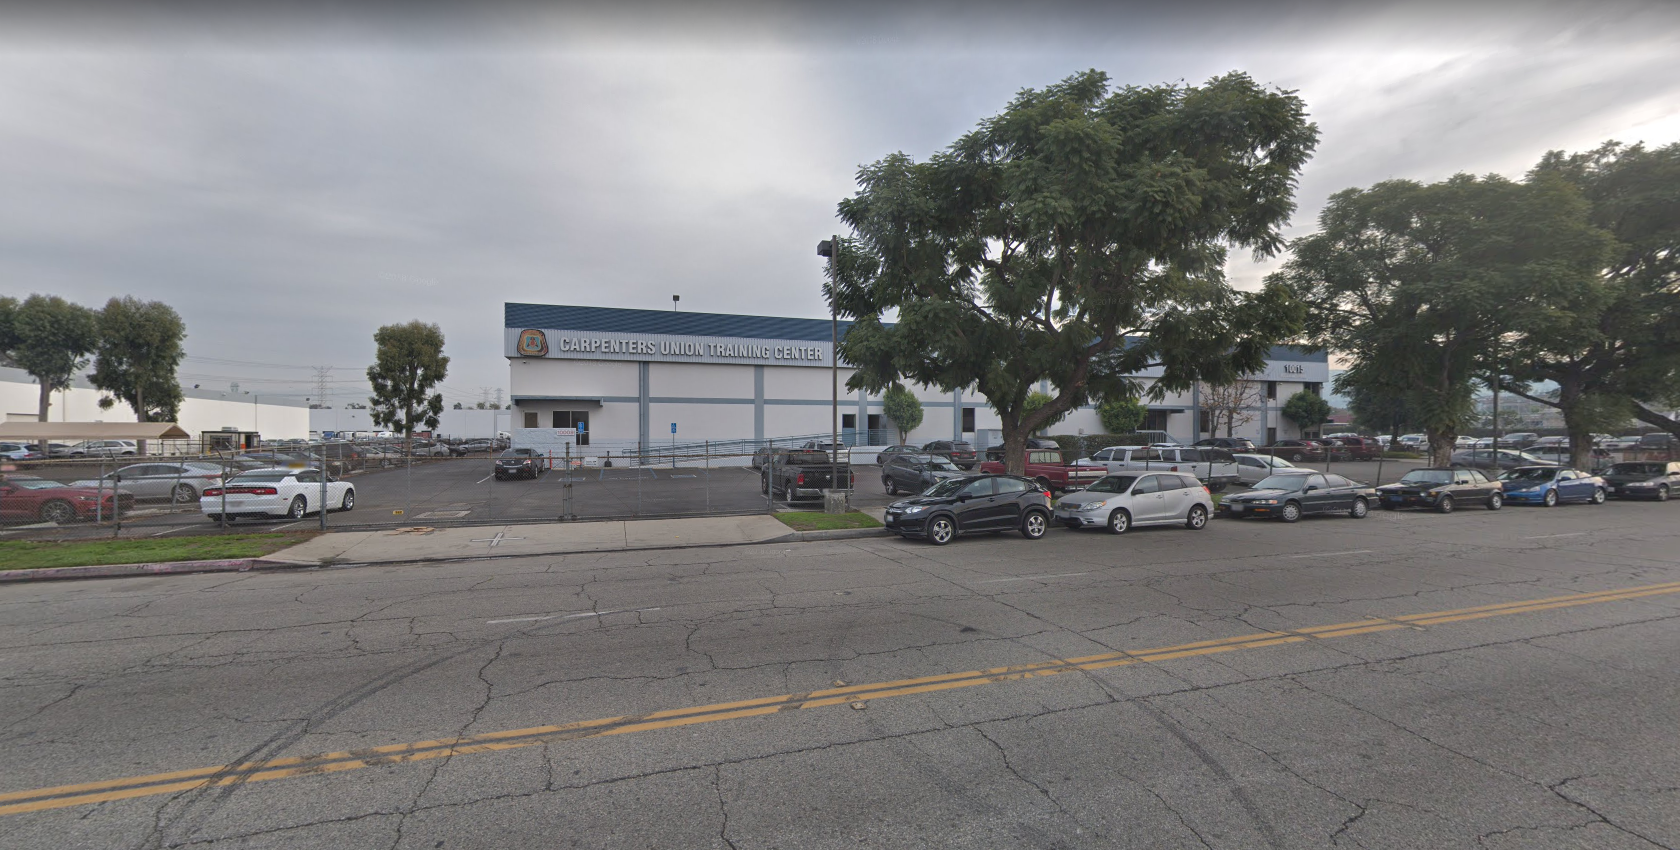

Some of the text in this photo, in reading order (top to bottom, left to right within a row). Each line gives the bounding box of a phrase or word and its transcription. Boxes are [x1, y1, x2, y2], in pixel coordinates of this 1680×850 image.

[559, 336, 823, 360] CARPENTERS UNION TRAINING CENTER
